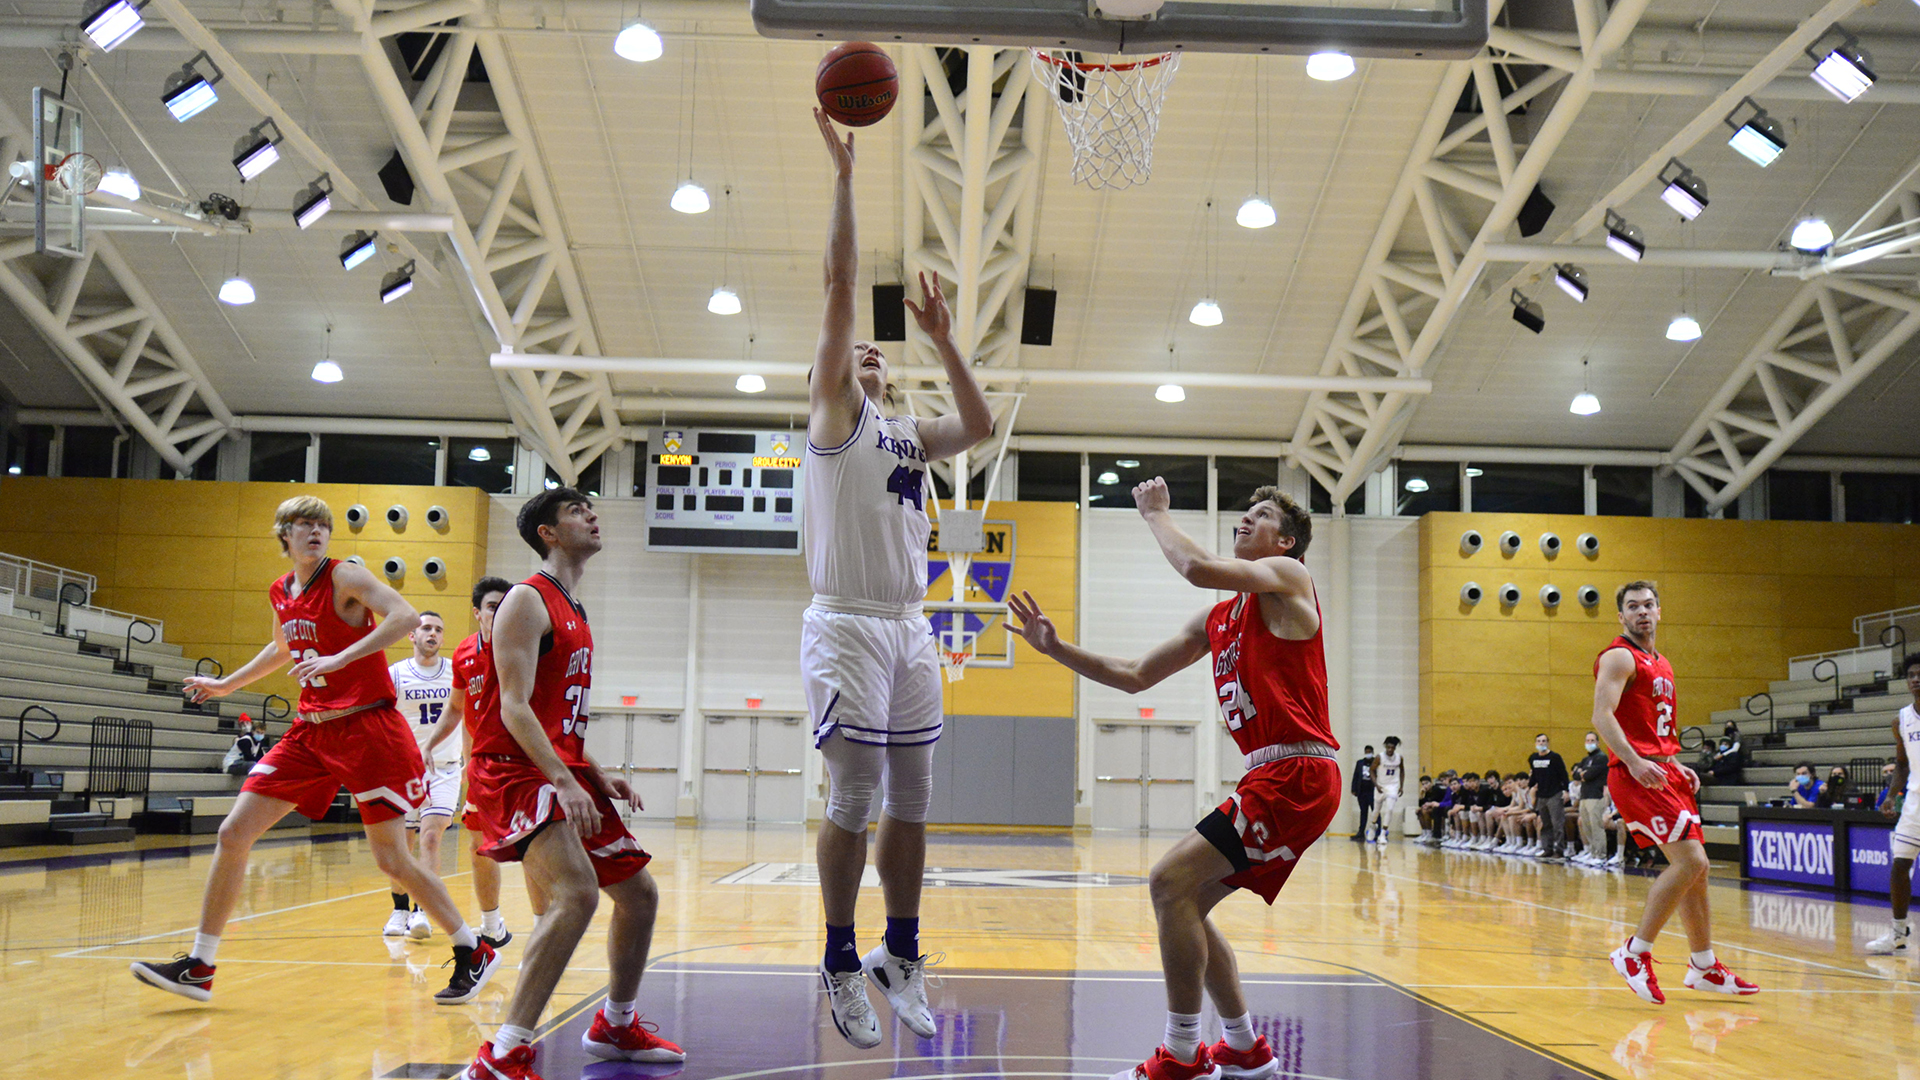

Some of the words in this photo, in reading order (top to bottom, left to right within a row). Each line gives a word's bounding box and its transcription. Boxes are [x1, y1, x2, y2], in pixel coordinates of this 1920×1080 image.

[837, 90, 891, 109] Wilson
[876, 430, 926, 463] KENYO
[659, 454, 693, 466] KENYON
[715, 461, 736, 469] PERIOD
[887, 464, 924, 511] 44
[298, 619, 319, 643] CITY
[562, 684, 592, 739] 35
[1218, 669, 1258, 732] 24
[419, 702, 443, 725] 15
[1656, 701, 1677, 737] 2
[405, 778, 424, 801] G
[1650, 815, 1669, 836] G
[1750, 829, 1834, 876] KENYON
[1852, 849, 1889, 866] LORDS
